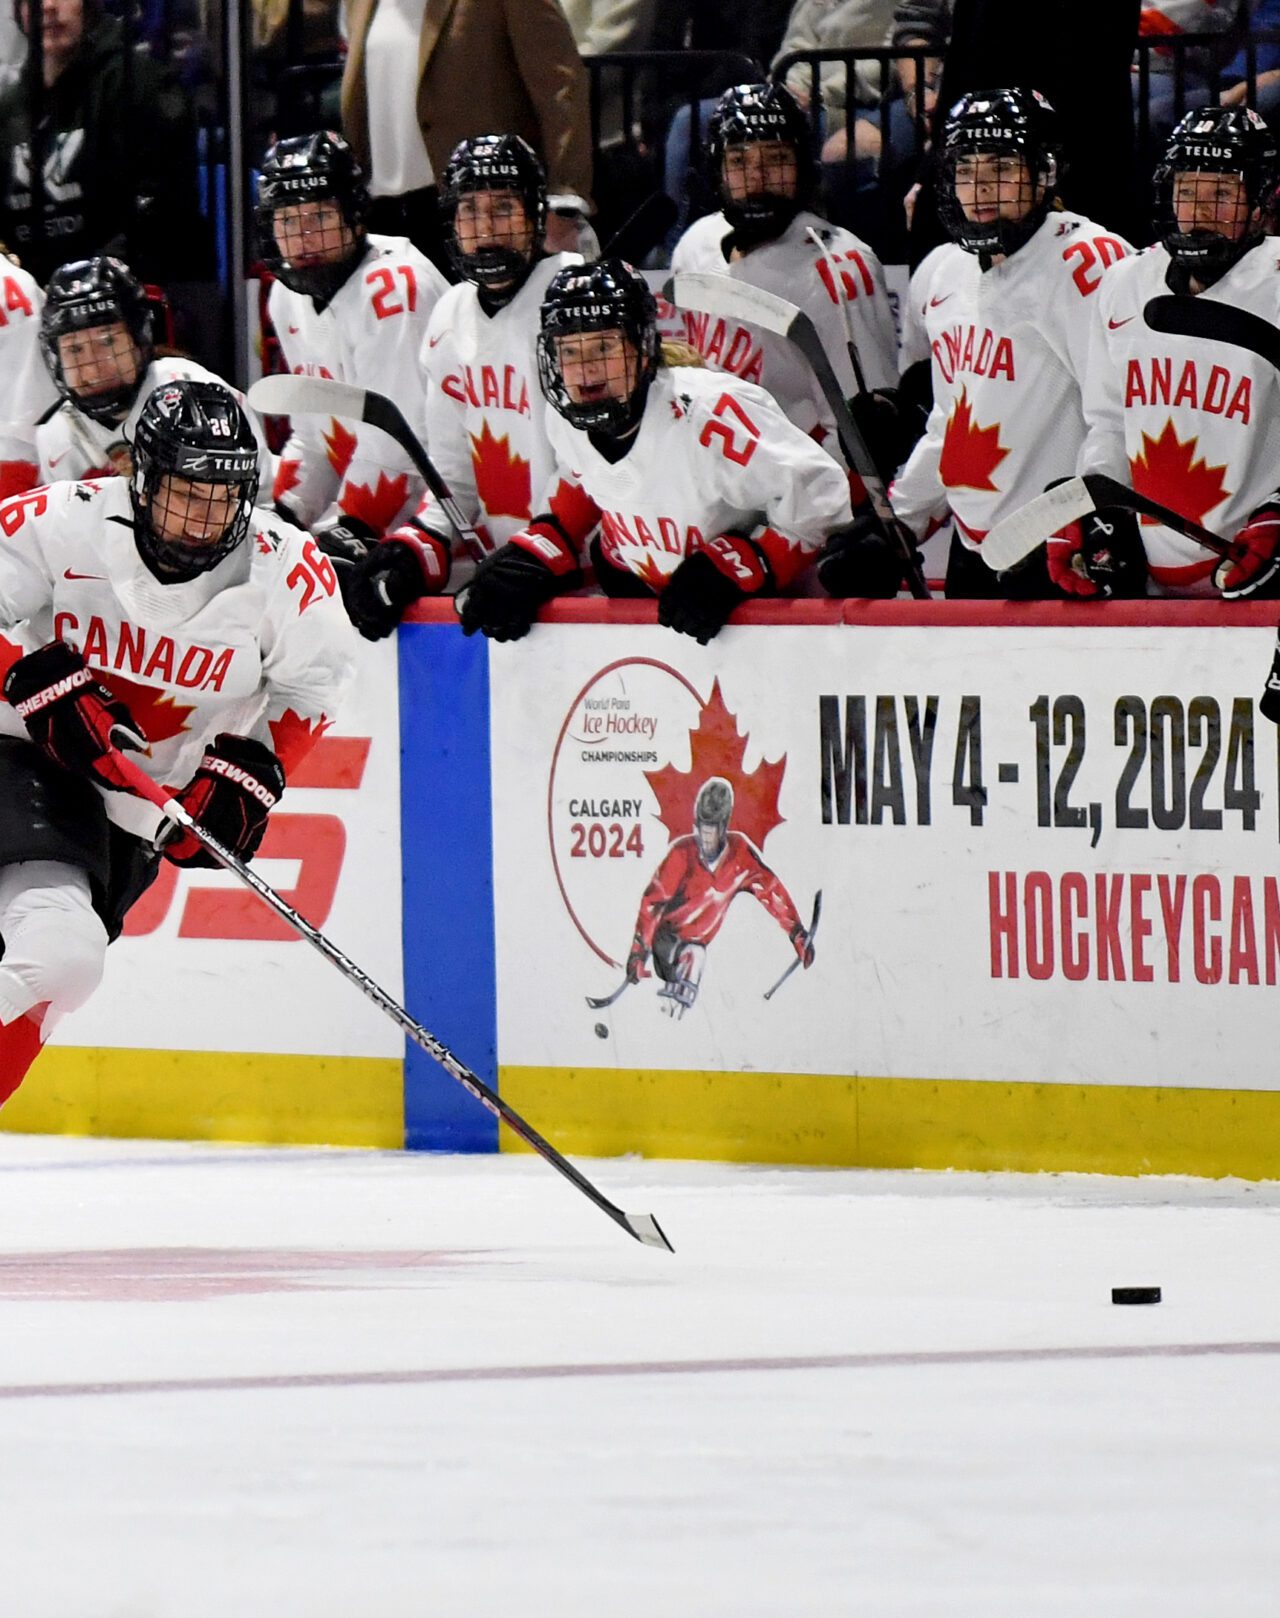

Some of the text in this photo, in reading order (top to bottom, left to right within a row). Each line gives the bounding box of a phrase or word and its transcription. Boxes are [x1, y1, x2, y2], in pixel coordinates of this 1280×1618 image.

[966, 128, 1013, 139] TELUS
[1185, 145, 1233, 159] TELUS
[473, 164, 519, 176] TELUS
[283, 176, 328, 191] TELUS
[366, 265, 417, 319] 21
[70, 299, 116, 317] TELUS
[565, 304, 612, 318] TELUS
[1125, 357, 1253, 426] ANADA
[209, 417, 231, 437] 26
[699, 392, 761, 467] 27
[214, 458, 256, 471] TELUS
[287, 541, 336, 615] 26
[54, 612, 234, 692] CANADA
[15, 667, 93, 717] SHERWOO
[584, 697, 631, 711] World Para
[583, 713, 658, 741] Ice Hockey
[581, 751, 658, 763] CHAMPIONSHIPS
[819, 695, 939, 825] MAY
[1114, 695, 1261, 831] 2024
[201, 755, 276, 809] ERWOOD
[569, 799, 643, 818] CALGARY
[570, 823, 645, 858] 2024
